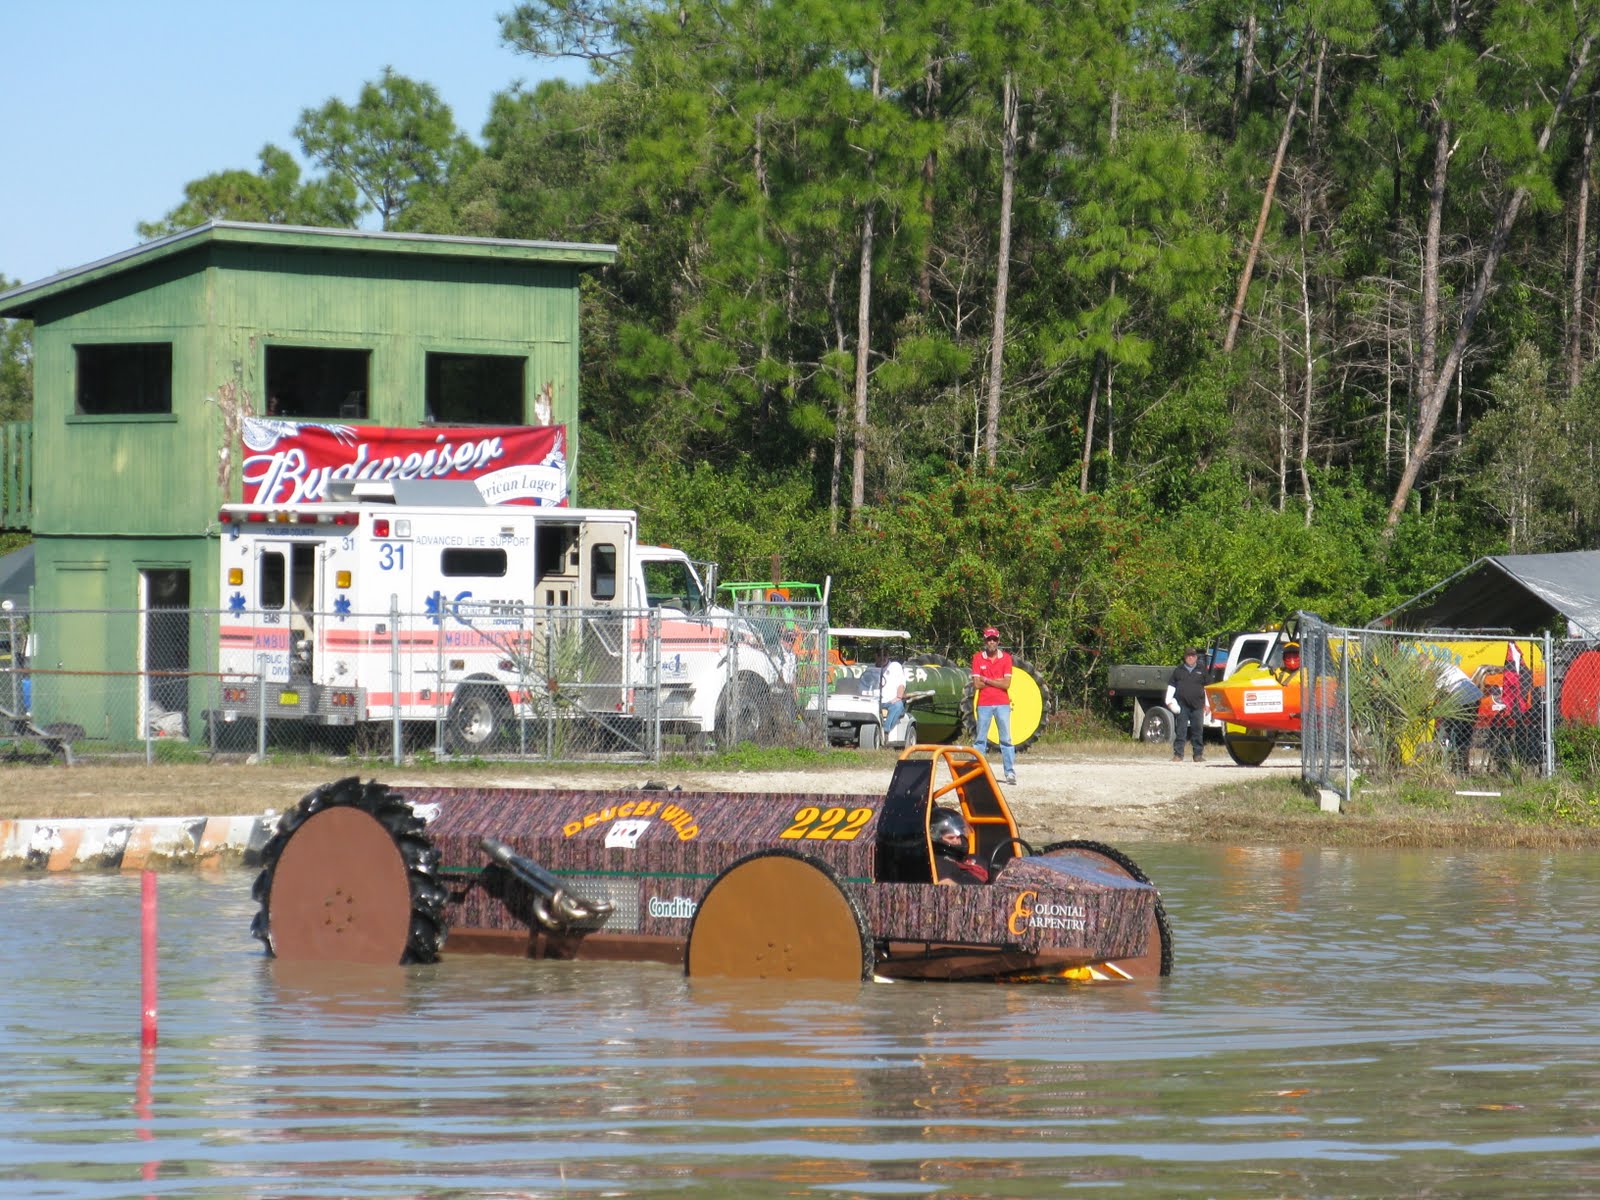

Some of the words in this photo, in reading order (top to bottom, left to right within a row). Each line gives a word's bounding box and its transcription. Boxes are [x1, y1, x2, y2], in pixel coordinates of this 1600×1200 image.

[242, 435, 503, 504] Budweiser
[480, 480, 518, 500] erican
[521, 474, 557, 492] Lager
[341, 536, 355, 551] 31
[415, 535, 463, 546] ADVANCED
[467, 536, 485, 547] LIFE
[489, 536, 531, 547] SUPPORT
[379, 543, 404, 570] 31
[490, 600, 525, 615] EMS
[263, 612, 281, 624] EMS
[255, 634, 289, 648] AMBU
[437, 630, 511, 647] MBULANCE
[256, 653, 282, 664] PBLIC
[562, 801, 662, 838] DEUCES
[660, 804, 698, 841] WILD
[779, 806, 873, 840] 222
[649, 896, 698, 919] Conditio
